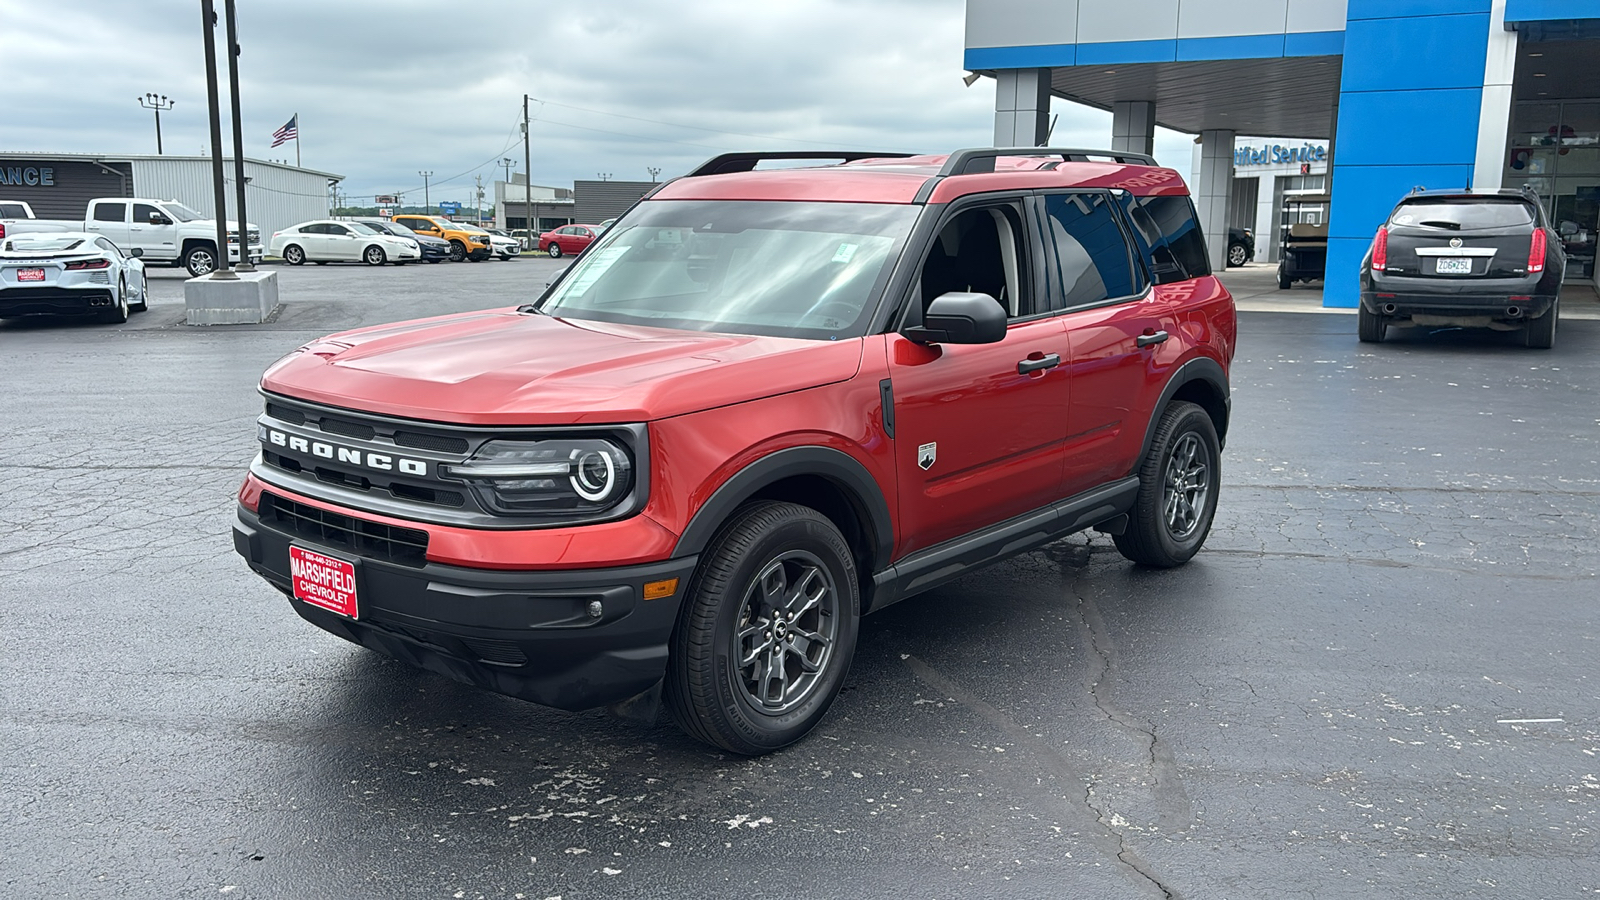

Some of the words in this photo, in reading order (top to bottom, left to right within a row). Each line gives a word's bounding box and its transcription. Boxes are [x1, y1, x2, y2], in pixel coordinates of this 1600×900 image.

[1271, 142, 1325, 163] Service
[269, 430, 427, 476] BRONCO
[291, 557, 354, 594] MARSHFIELD
[300, 580, 348, 605] CHEVROLET
[729, 707, 763, 741] MICHELIN
